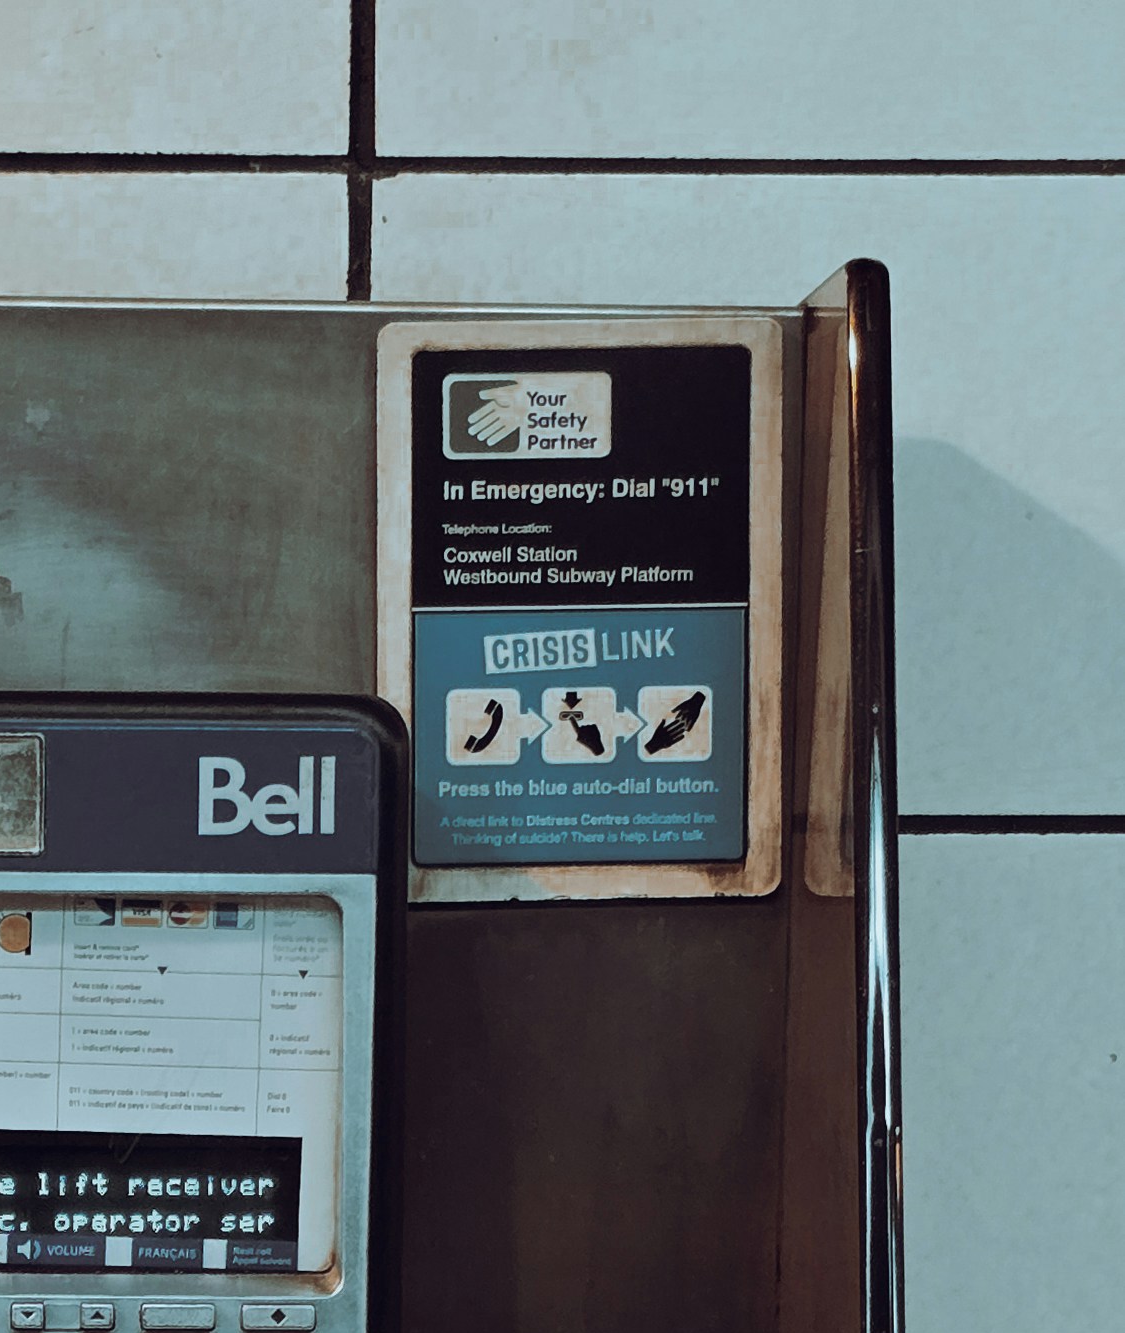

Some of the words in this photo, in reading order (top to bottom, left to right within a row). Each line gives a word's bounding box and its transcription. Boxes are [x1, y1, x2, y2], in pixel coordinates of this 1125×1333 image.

[527, 391, 567, 408] Your
[527, 412, 588, 432] Safety
[527, 434, 597, 451] Partner
[443, 480, 463, 500] In
[471, 479, 605, 504] Emergency:
[612, 477, 655, 498] Dial
[662, 477, 720, 497] "911"
[442, 523, 499, 537] Telephone
[502, 522, 552, 535] Location:
[443, 546, 511, 564] Coxwell
[517, 545, 578, 562] Station
[443, 567, 541, 586] Westbound
[547, 566, 616, 587] Subway
[621, 565, 693, 584] Platform
[492, 634, 590, 669] CRISIS
[602, 627, 676, 662] LINK
[198, 755, 336, 836] Bell
[438, 781, 489, 798] Press
[495, 780, 523, 797] the
[528, 779, 568, 796] blue
[572, 778, 651, 796] auto-dial
[656, 777, 720, 795] button.
[526, 814, 578, 827] Distress
[581, 813, 630, 826] Centres
[37, 1170, 110, 1196] lift
[127, 1172, 275, 1197] receiver
[53, 1208, 201, 1233] operator
[220, 1210, 275, 1233] ser
[46, 1244, 96, 1258] VOLUME
[138, 1247, 197, 1262] FRANÇAIS
